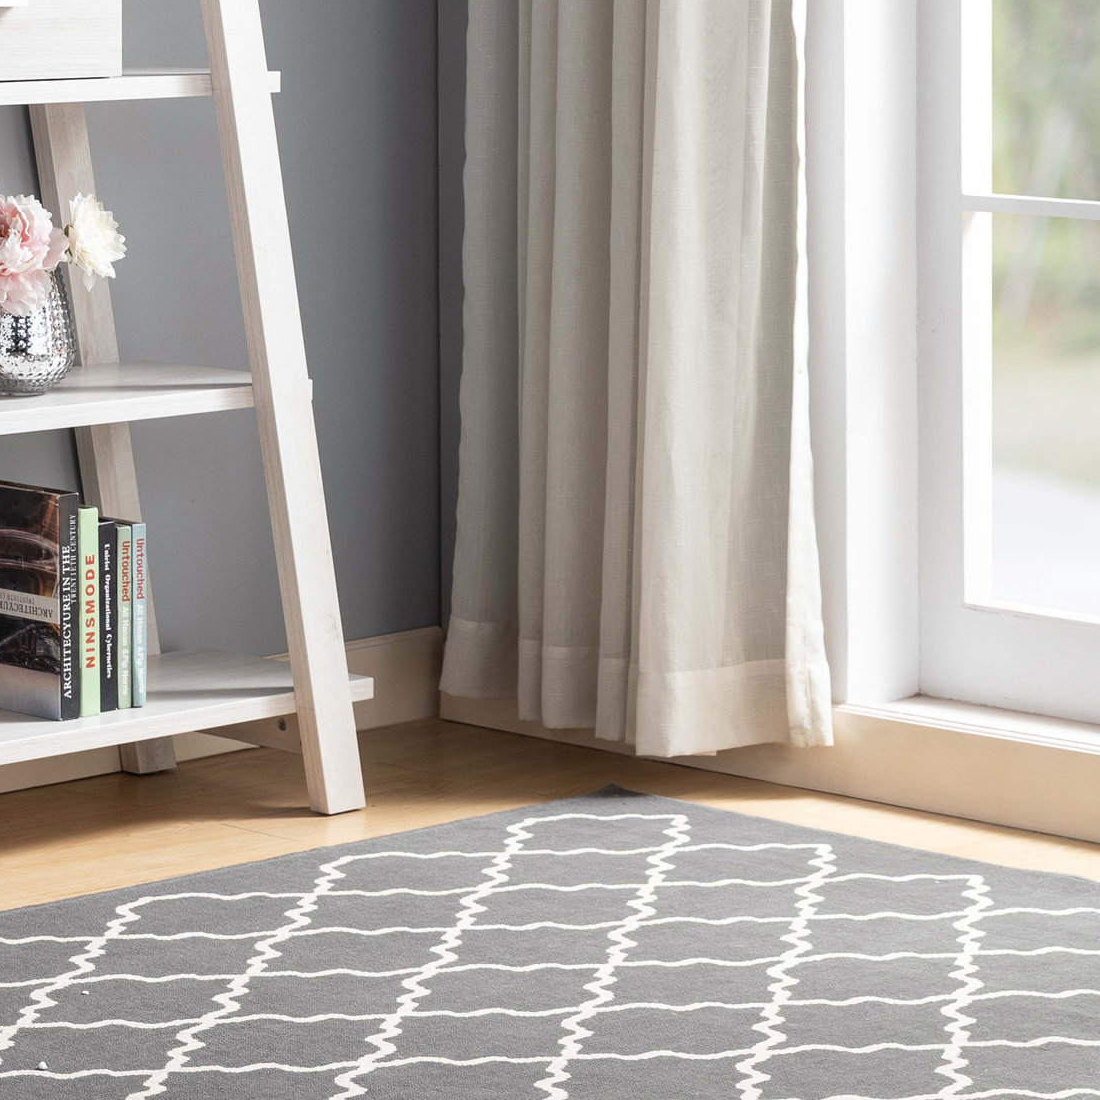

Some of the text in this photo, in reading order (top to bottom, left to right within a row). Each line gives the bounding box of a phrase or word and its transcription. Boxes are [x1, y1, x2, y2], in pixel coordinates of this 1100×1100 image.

[69, 514, 77, 552] CENTURY
[121, 540, 131, 602] Untouched
[136, 538, 145, 600] Untouched
[62, 545, 72, 699] ARCHITECYURE IN THE
[85, 554, 95, 669] NINSMODE
[104, 574, 112, 631] Organizational
[105, 633, 113, 679] Cybernetics
